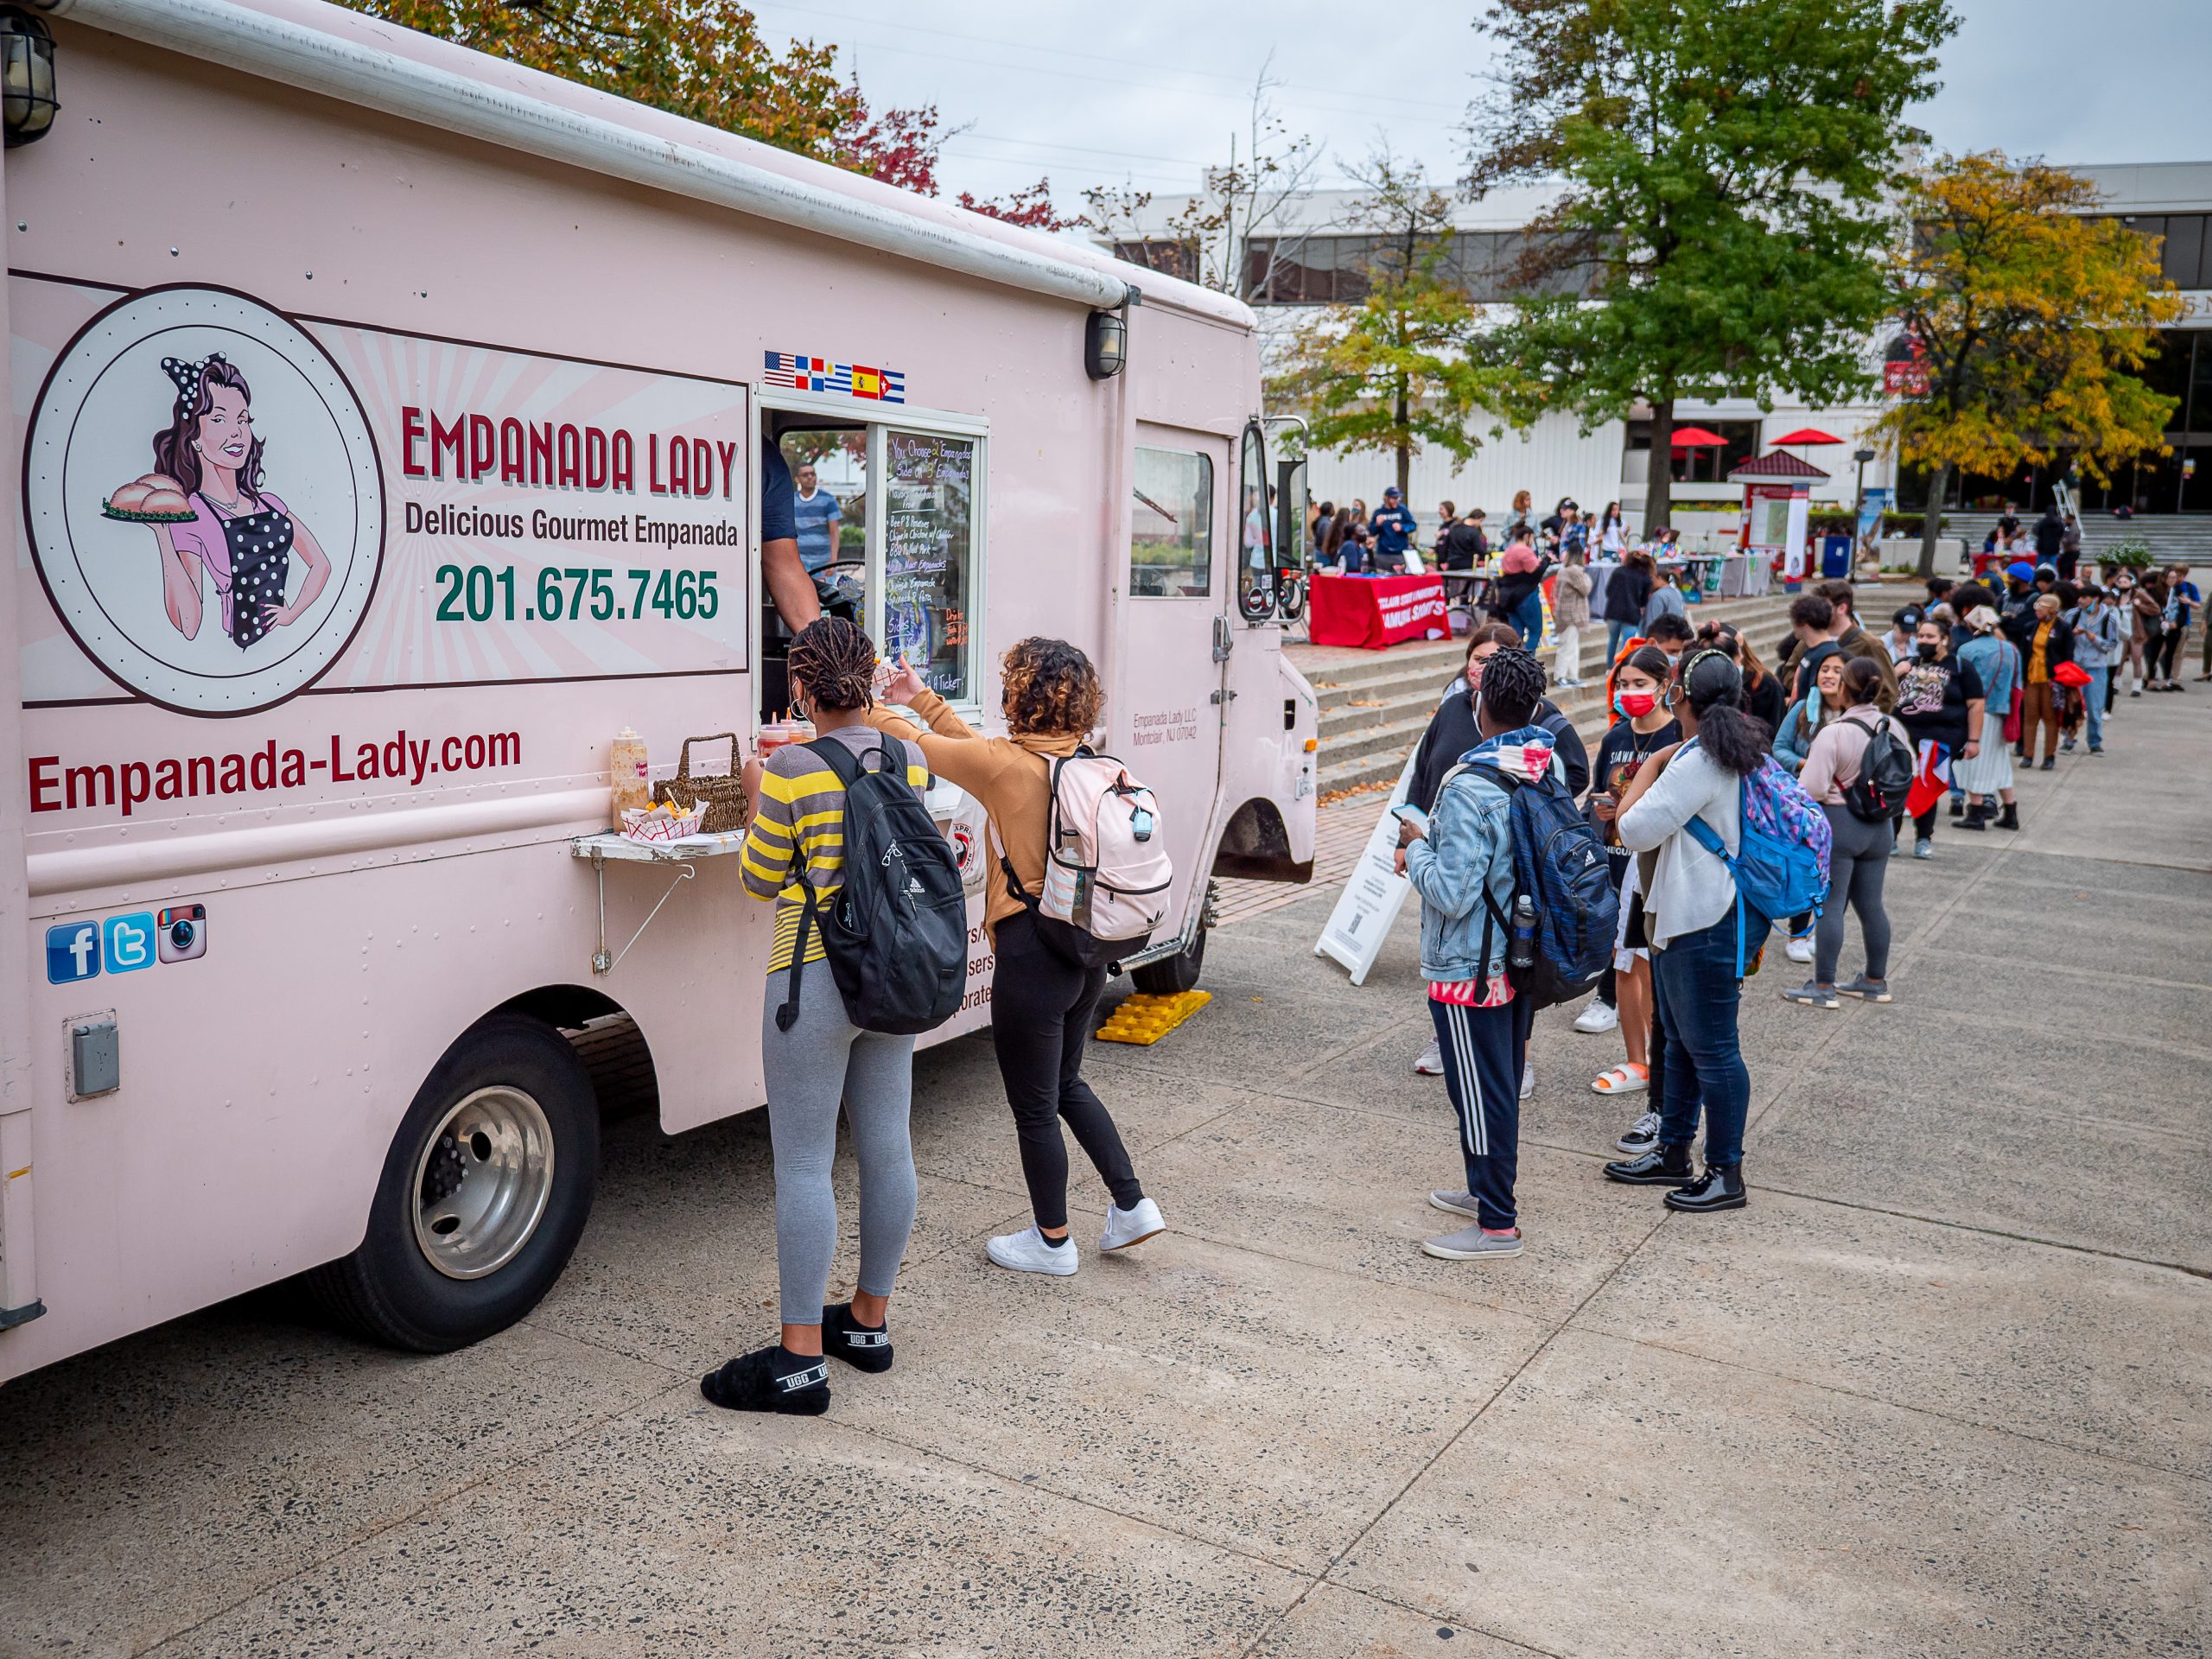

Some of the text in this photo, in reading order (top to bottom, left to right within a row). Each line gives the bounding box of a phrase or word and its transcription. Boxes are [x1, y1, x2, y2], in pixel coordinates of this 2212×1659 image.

[403, 406, 738, 500] EMPANADA LADY
[891, 437, 906, 460] You
[405, 501, 738, 550] Delicious Gourmet Empanada
[435, 564, 718, 622] 201.675.7465
[1134, 708, 1197, 729] Empanada Lady LLC
[1166, 728, 1175, 742] NJ
[1176, 726, 1197, 741] 07042
[29, 730, 520, 817] Empanada-Lady.com
[958, 985, 992, 1013] orate
[850, 1334, 866, 1344] UGG
[786, 1373, 810, 1388] UGG
